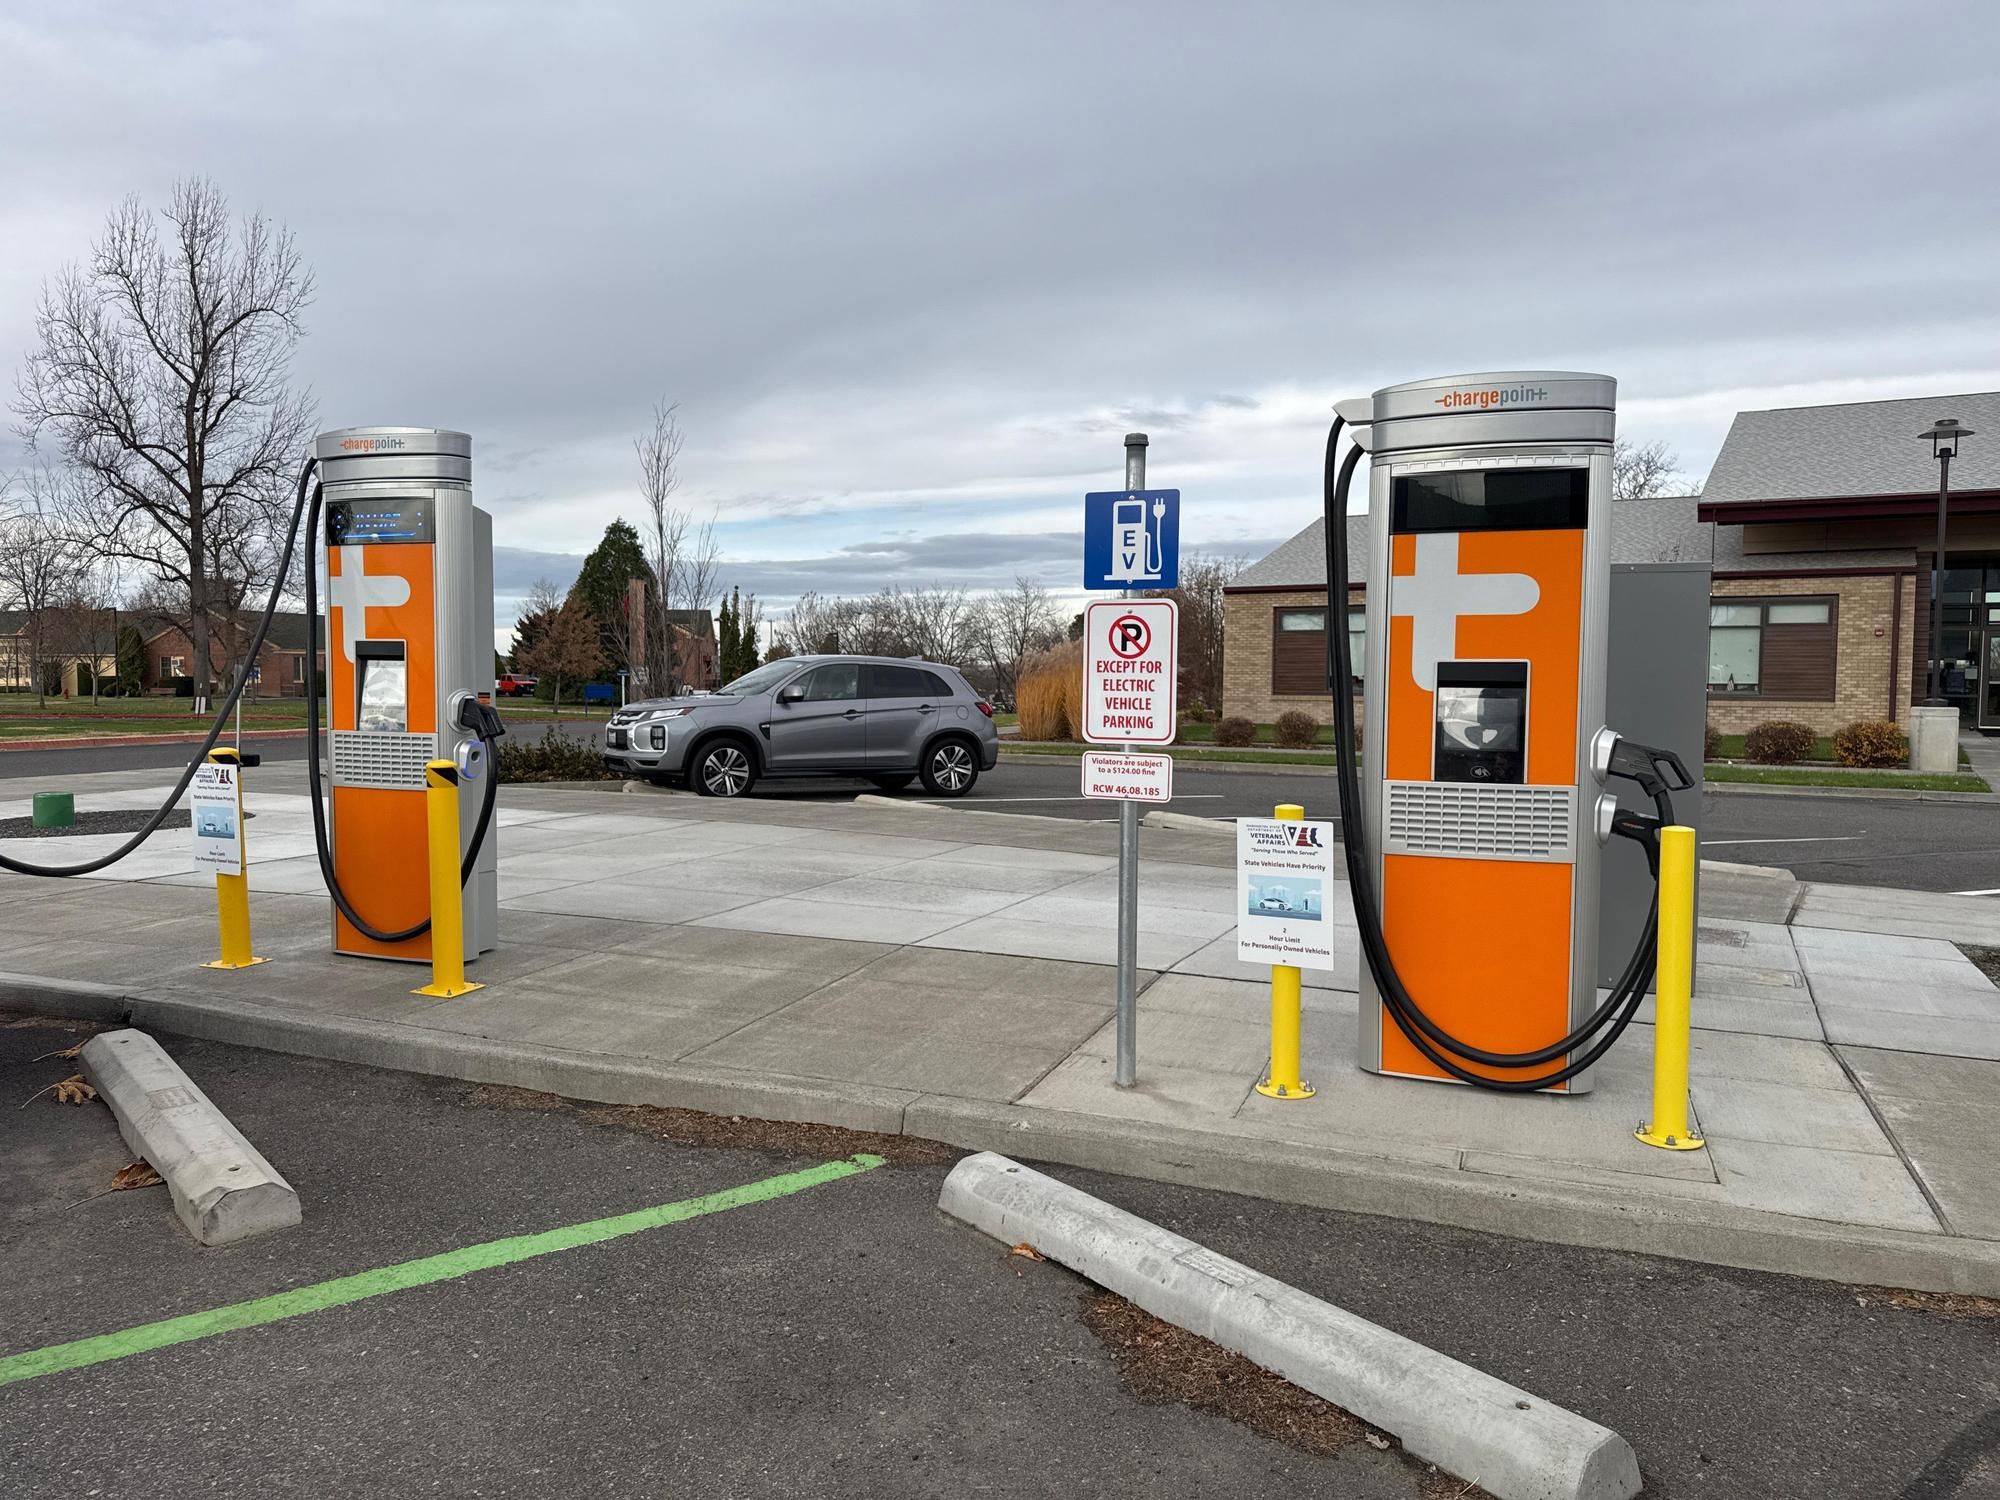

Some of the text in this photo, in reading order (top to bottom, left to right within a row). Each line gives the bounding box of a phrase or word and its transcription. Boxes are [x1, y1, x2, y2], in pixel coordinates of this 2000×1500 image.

[1097, 661, 1162, 673] EXCEPT FOR
[1103, 679, 1155, 692] ELECTRIC
[1105, 697, 1151, 710] VEHICLE
[1103, 715, 1153, 729] PARKING
[1092, 758, 1122, 766] Violators
[1137, 761, 1163, 769] subject
[1113, 767, 1141, 775] $124.00
[1093, 785, 1160, 796] RCW 46.08.185
[1302, 864, 1326, 872] Priority
[1252, 942, 1282, 951] Personally
